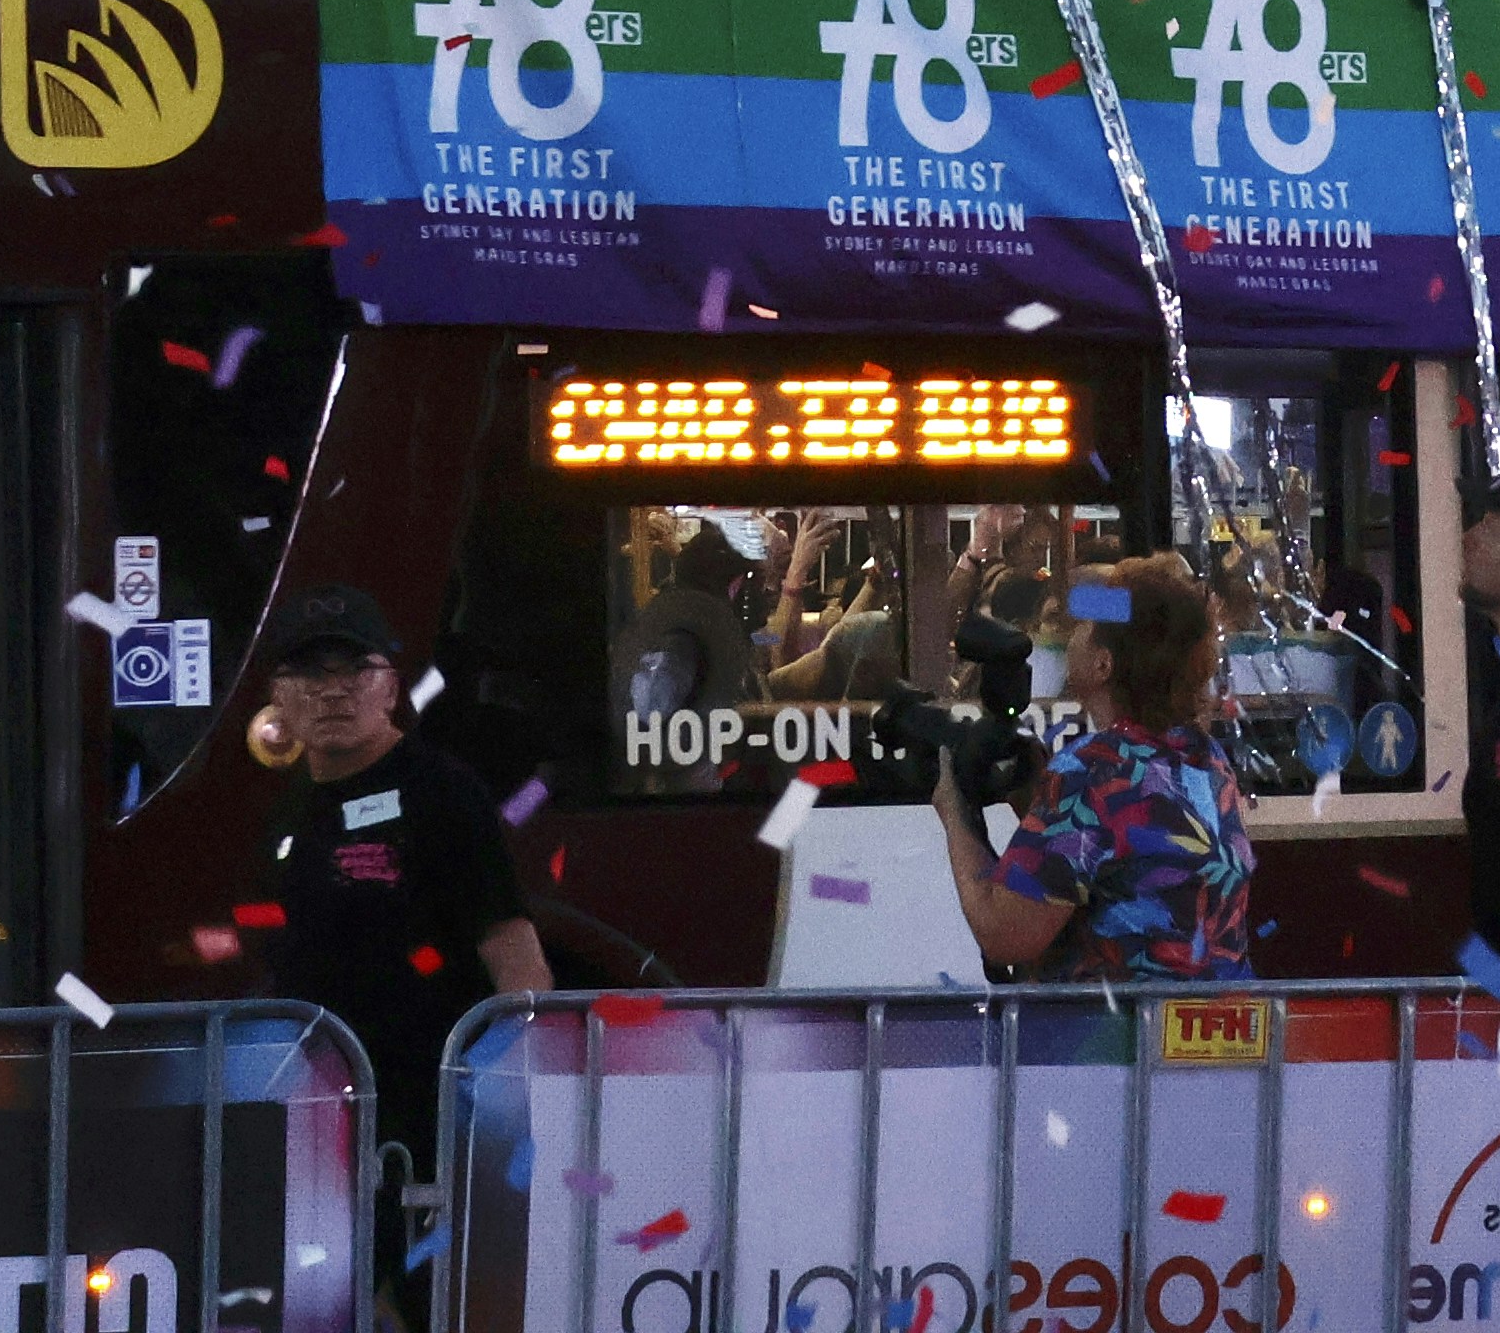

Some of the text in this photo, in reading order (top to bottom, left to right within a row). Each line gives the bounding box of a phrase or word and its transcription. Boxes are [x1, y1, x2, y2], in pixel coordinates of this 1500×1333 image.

[436, 142, 614, 180] THE FIRST
[843, 156, 1007, 193] THE FIRST
[423, 182, 636, 221] GENERATION
[1200, 175, 1349, 211] THE FIRST
[826, 196, 1025, 233] GENERATION
[625, 706, 851, 767] HOP-ON
